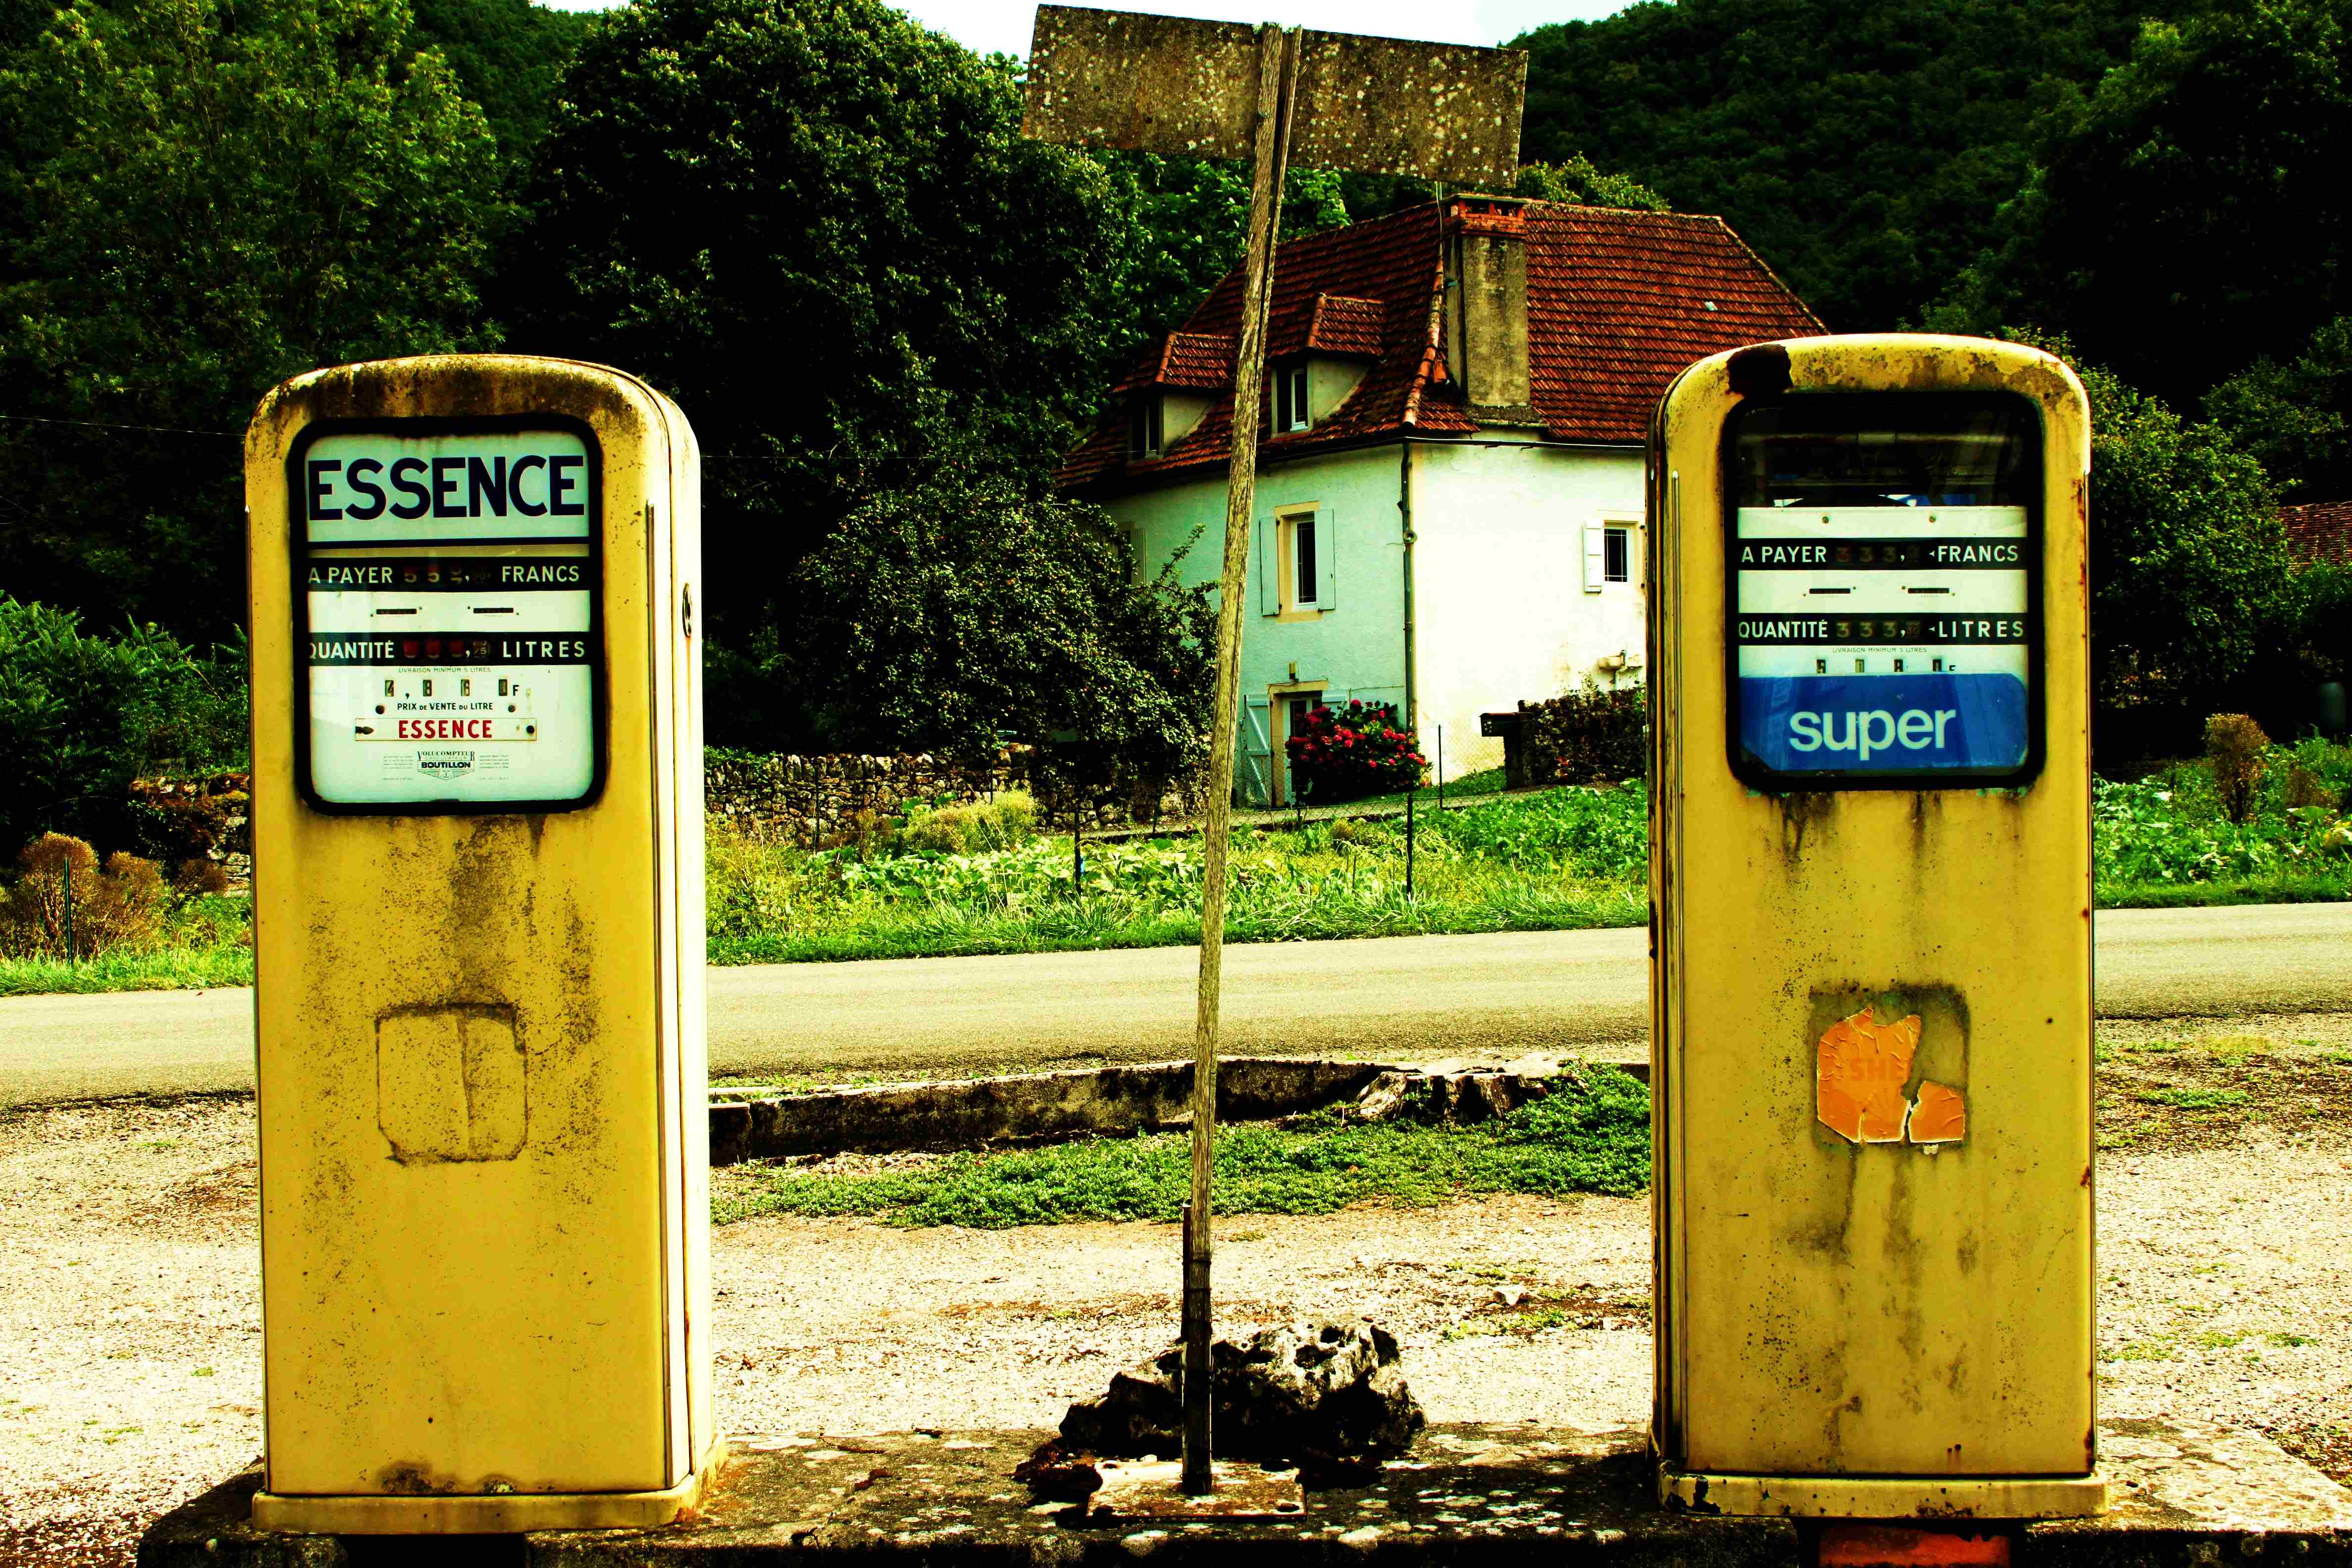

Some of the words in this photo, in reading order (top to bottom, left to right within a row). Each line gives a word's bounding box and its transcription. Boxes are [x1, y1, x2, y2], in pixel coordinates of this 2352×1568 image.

[308, 455, 585, 521] ESSENCE
[1742, 546, 1754, 562] A
[1762, 546, 1826, 562] PAYER
[1938, 545, 2018, 562] FRANCS
[308, 567, 321, 584] A
[328, 567, 392, 584] PAYER
[502, 566, 580, 582] FRANCS
[1739, 619, 1828, 638] QUANTITÉ
[1939, 621, 2023, 637] LITRES
[503, 641, 585, 658] LITRES
[513, 685, 519, 696] F
[399, 720, 492, 738] ESSENCE
[1789, 709, 1956, 761] super
